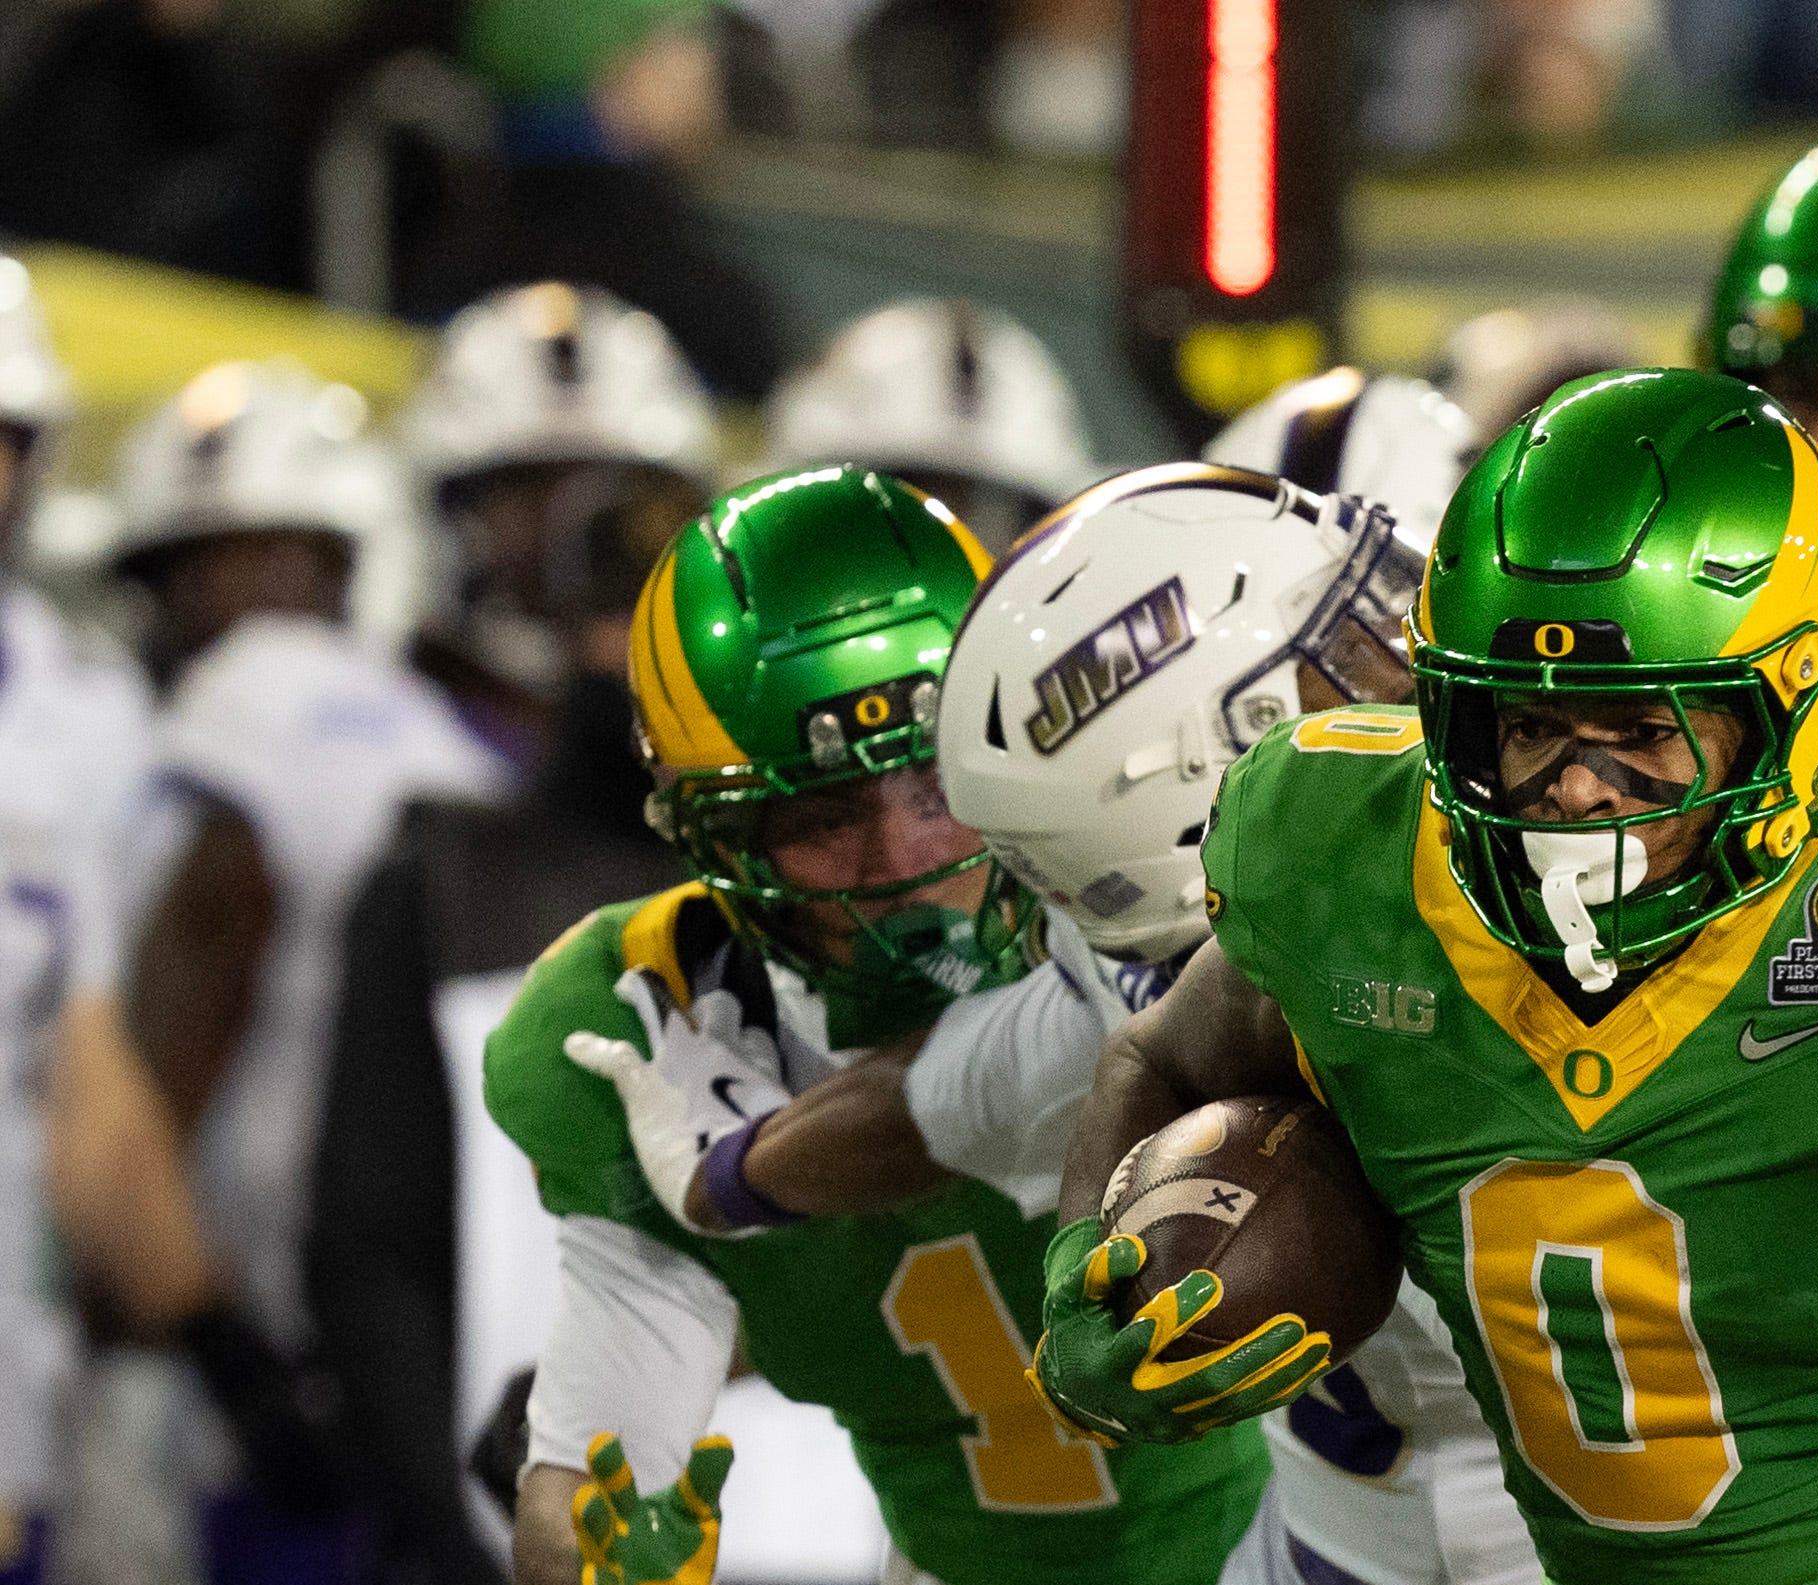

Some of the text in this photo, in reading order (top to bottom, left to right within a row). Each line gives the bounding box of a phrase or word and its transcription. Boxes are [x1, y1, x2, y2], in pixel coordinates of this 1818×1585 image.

[1024, 574, 1197, 759] JMU
[1534, 624, 1574, 658] O
[856, 695, 889, 727] O
[1563, 1049, 1613, 1099] O
[880, 1231, 1120, 1513] 1
[1458, 1157, 1742, 1532] 0
